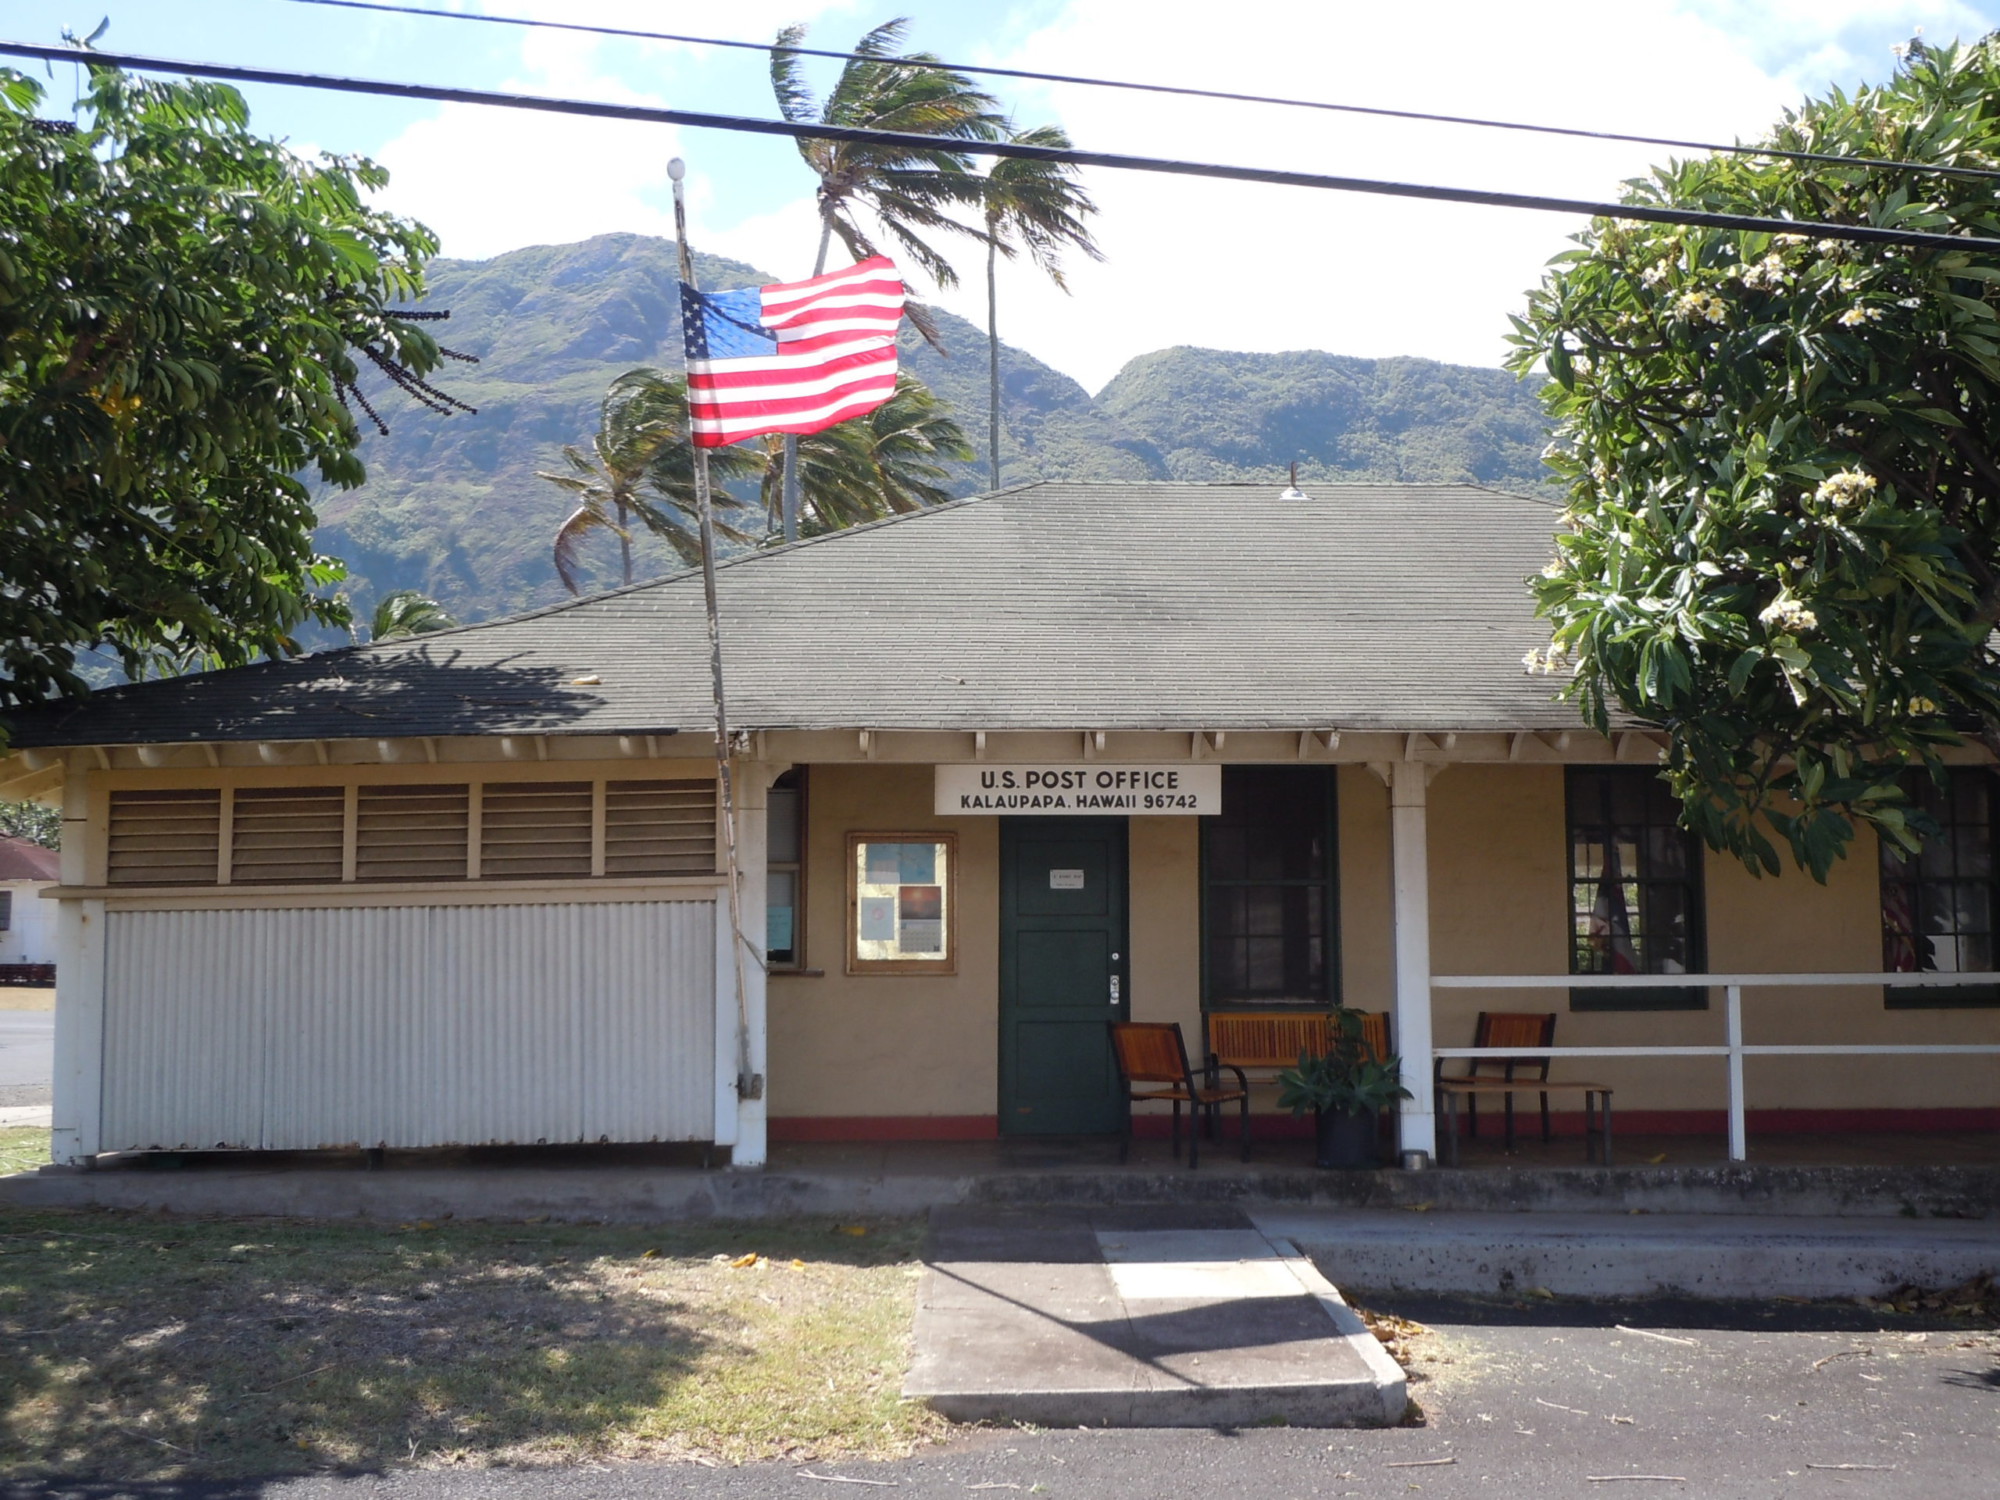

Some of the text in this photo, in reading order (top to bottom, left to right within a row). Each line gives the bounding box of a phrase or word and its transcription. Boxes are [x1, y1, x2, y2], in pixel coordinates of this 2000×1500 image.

[980, 770, 1179, 790] U.S. POST OFFICE
[1075, 794, 1137, 809] HAWAII
[1143, 794, 1198, 809] 96742
